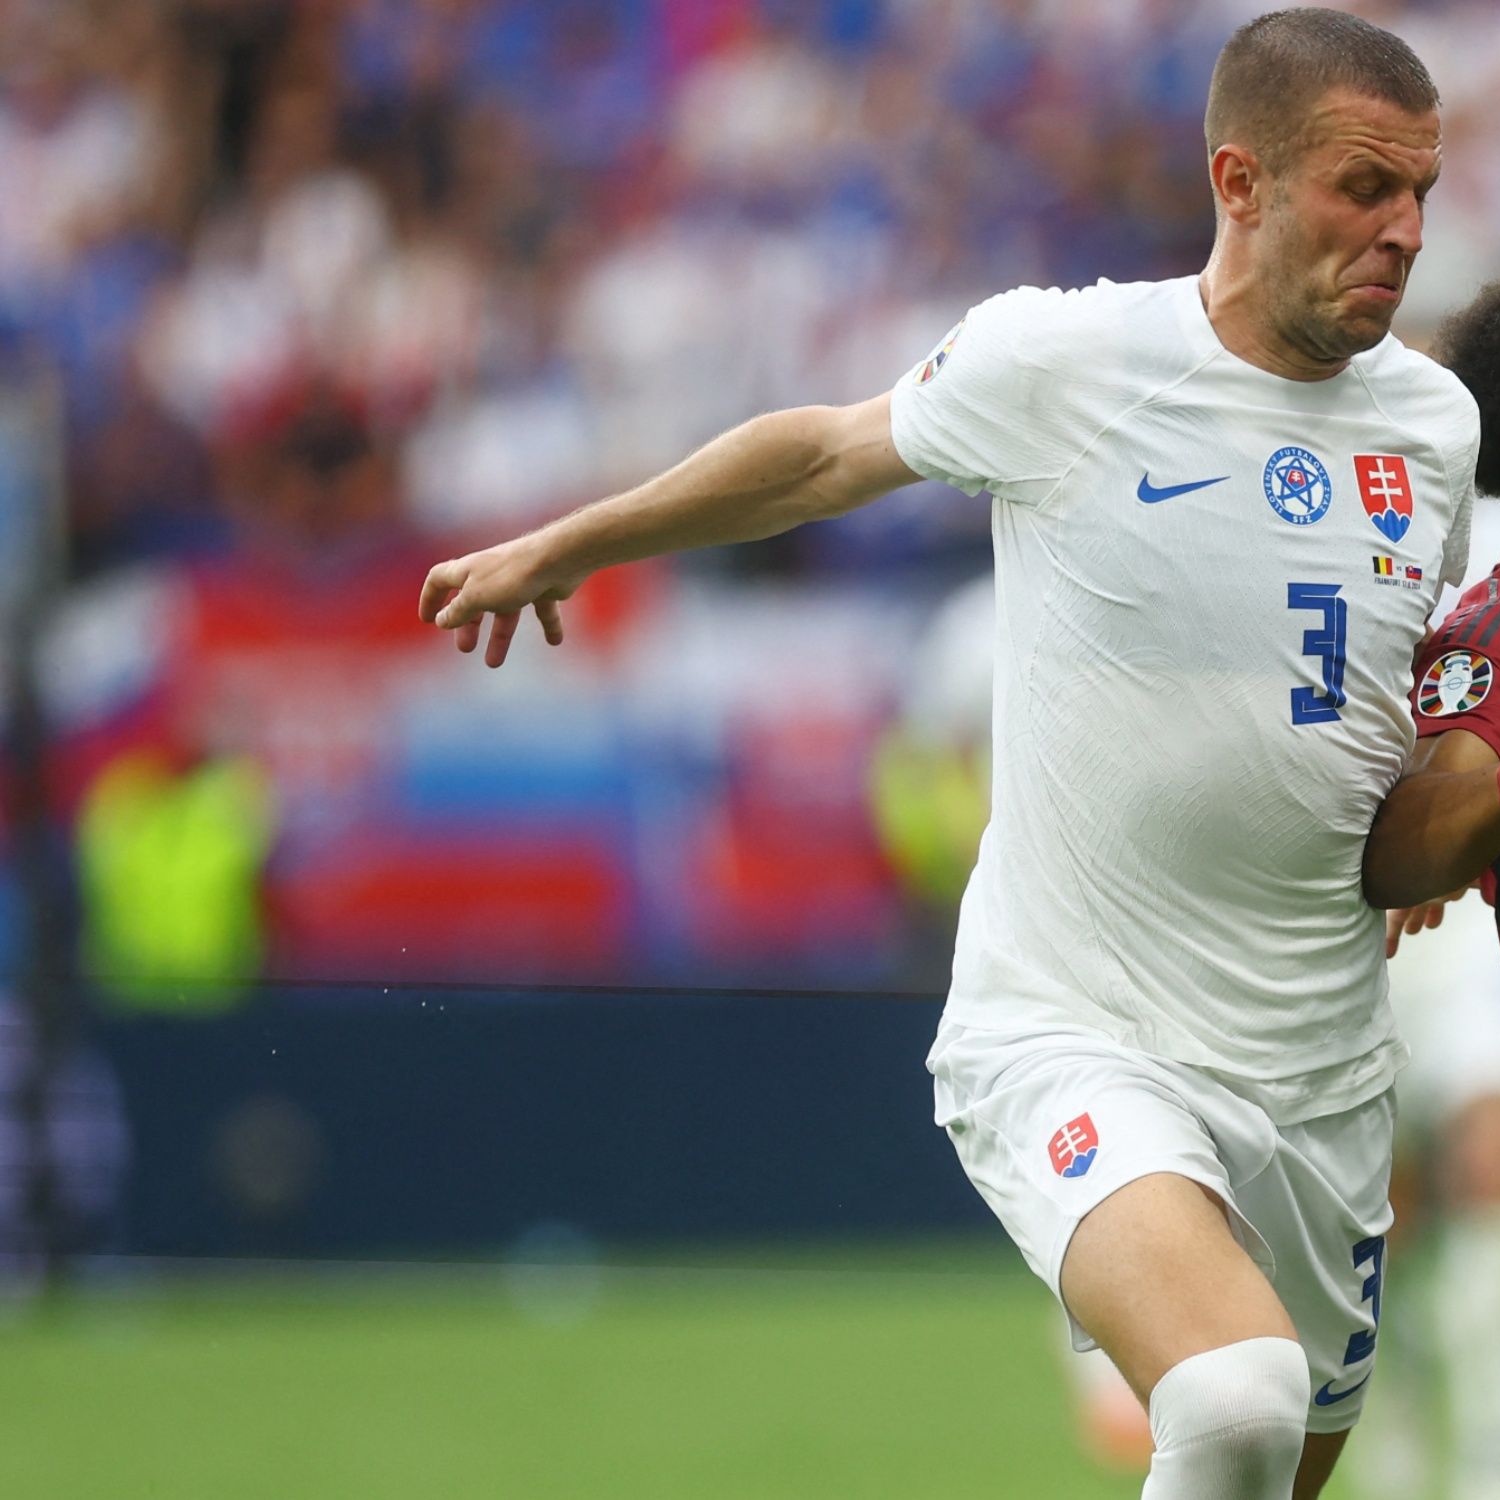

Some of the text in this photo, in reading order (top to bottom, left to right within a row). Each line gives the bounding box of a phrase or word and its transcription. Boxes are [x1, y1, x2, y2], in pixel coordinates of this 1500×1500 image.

[1292, 515, 1313, 525] SFZ
[1287, 582, 1348, 726] 3
[1343, 1235, 1385, 1367] 3
